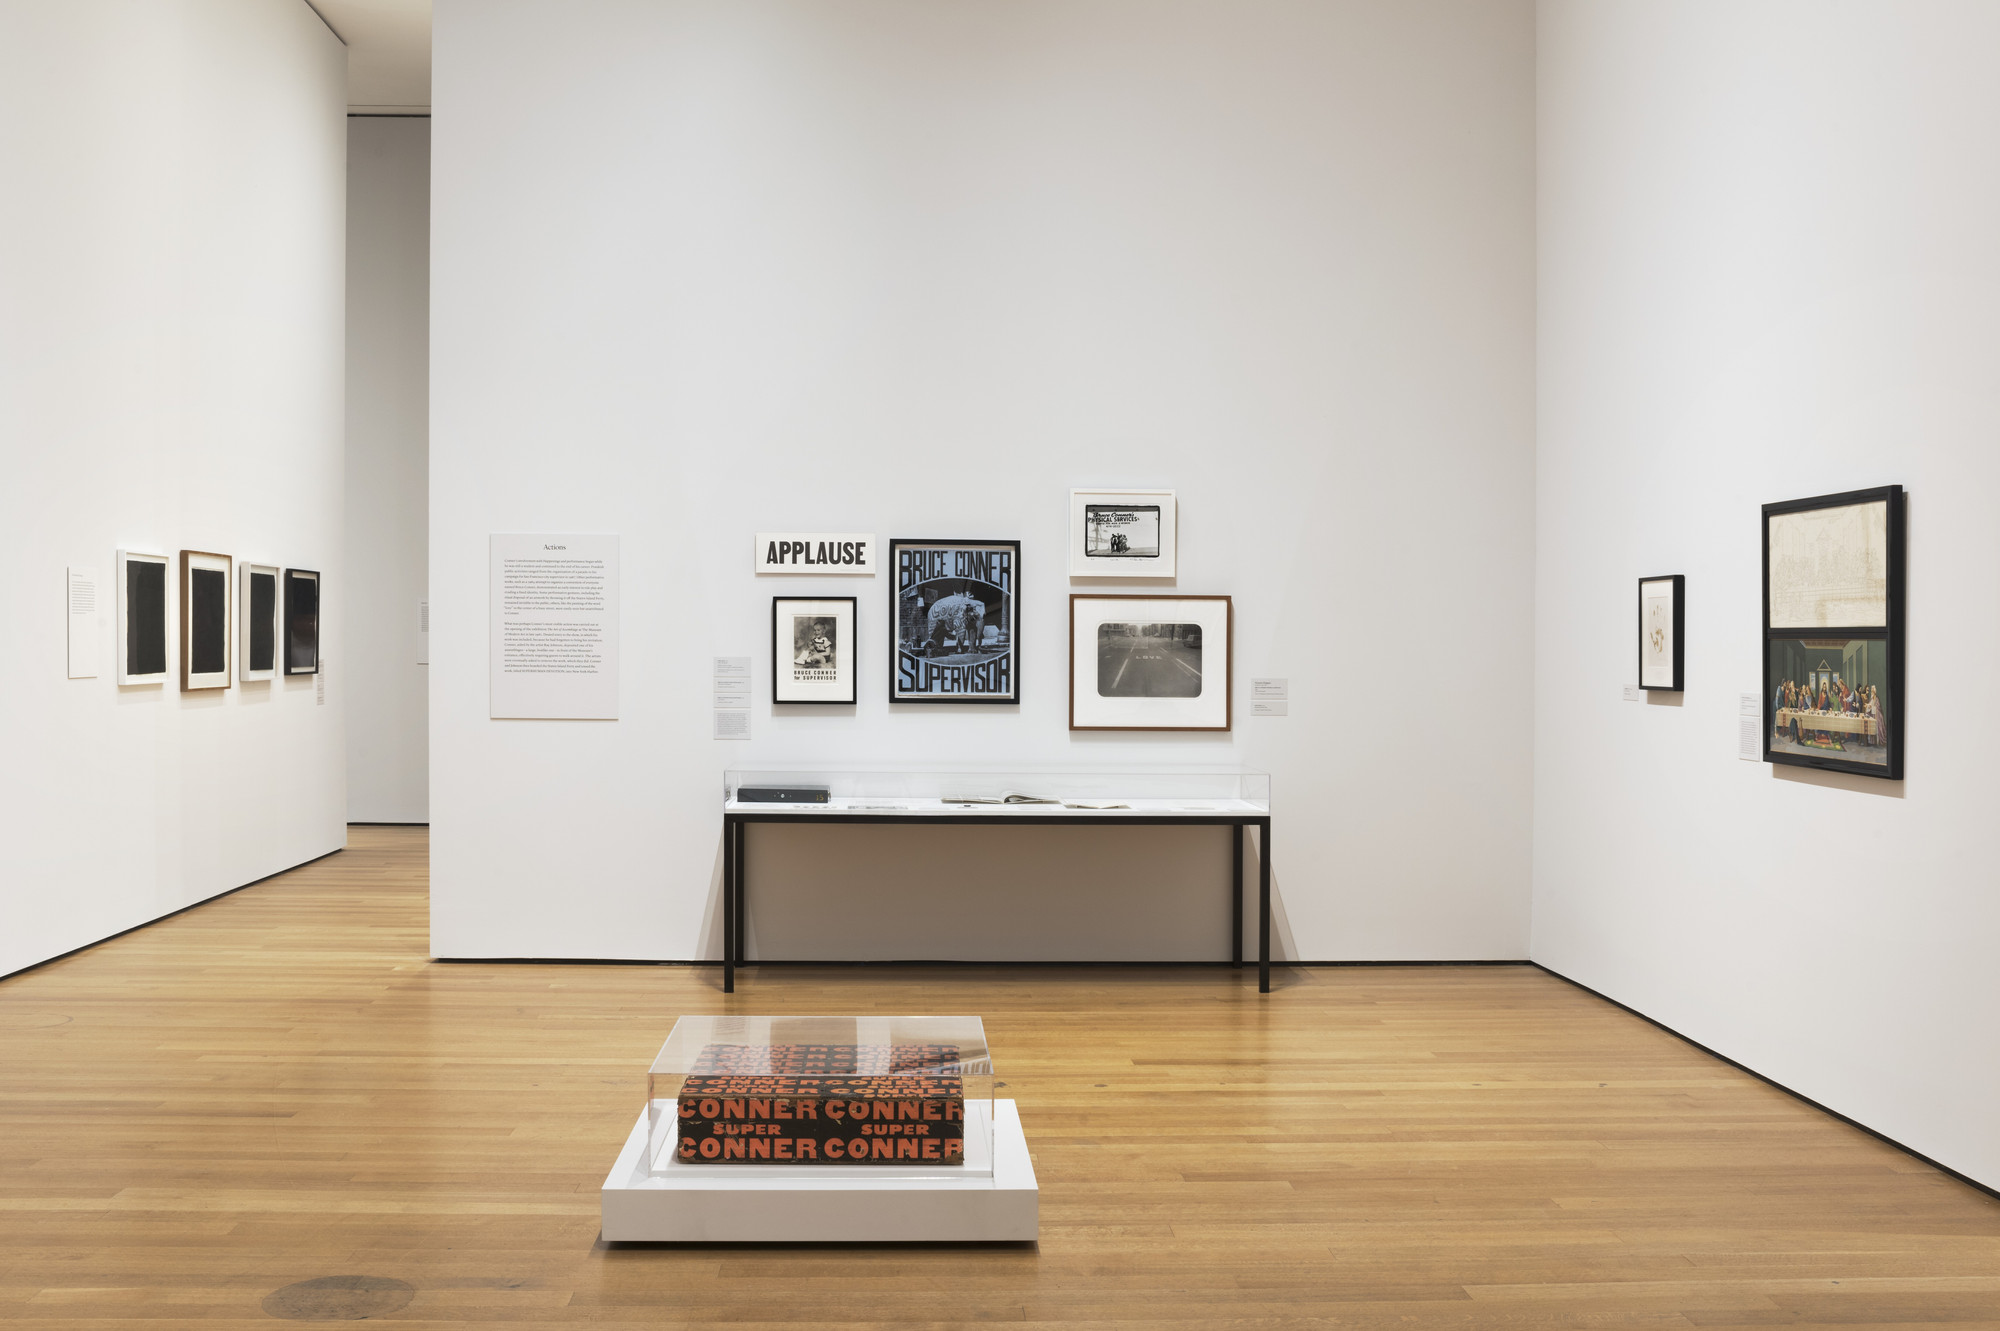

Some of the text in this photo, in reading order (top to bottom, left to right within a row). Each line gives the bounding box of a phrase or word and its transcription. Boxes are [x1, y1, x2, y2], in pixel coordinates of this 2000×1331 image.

[766, 540, 866, 566] APPLAUSE
[899, 550, 1011, 593] BRUCE CONNER
[899, 651, 1011, 693] SUPERVISOR
[679, 1099, 963, 1121] CONNER CONNER
[713, 1123, 930, 1136] SUPER SUPER
[680, 1137, 818, 1159] CONNER
